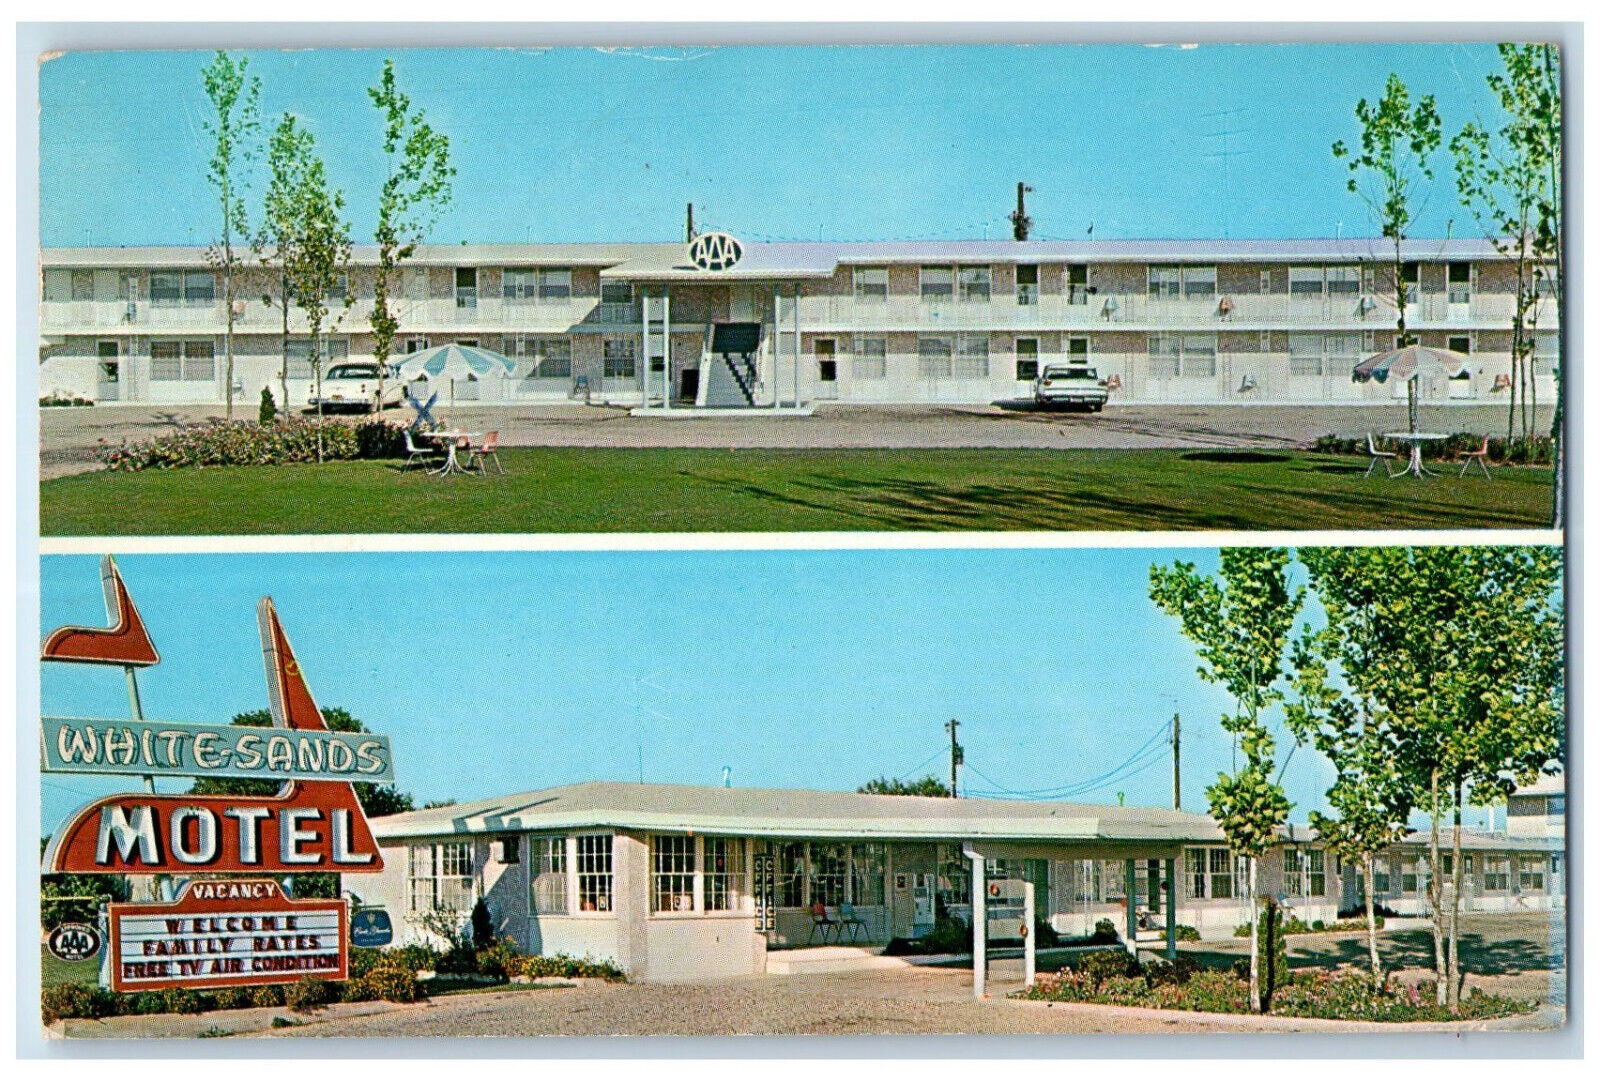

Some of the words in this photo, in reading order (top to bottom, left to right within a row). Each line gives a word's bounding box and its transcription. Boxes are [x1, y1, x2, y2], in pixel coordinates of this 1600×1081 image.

[695, 233, 736, 270] AAA
[95, 804, 375, 866] MOTEL
[192, 883, 276, 900] VACANCY
[165, 916, 299, 935] WELCOME
[60, 929, 89, 953] AAA
[143, 937, 233, 956] FAMILY
[253, 934, 321, 952] RATES
[123, 961, 170, 979] FREE
[179, 959, 201, 976] TV
[211, 957, 244, 974] AIR
